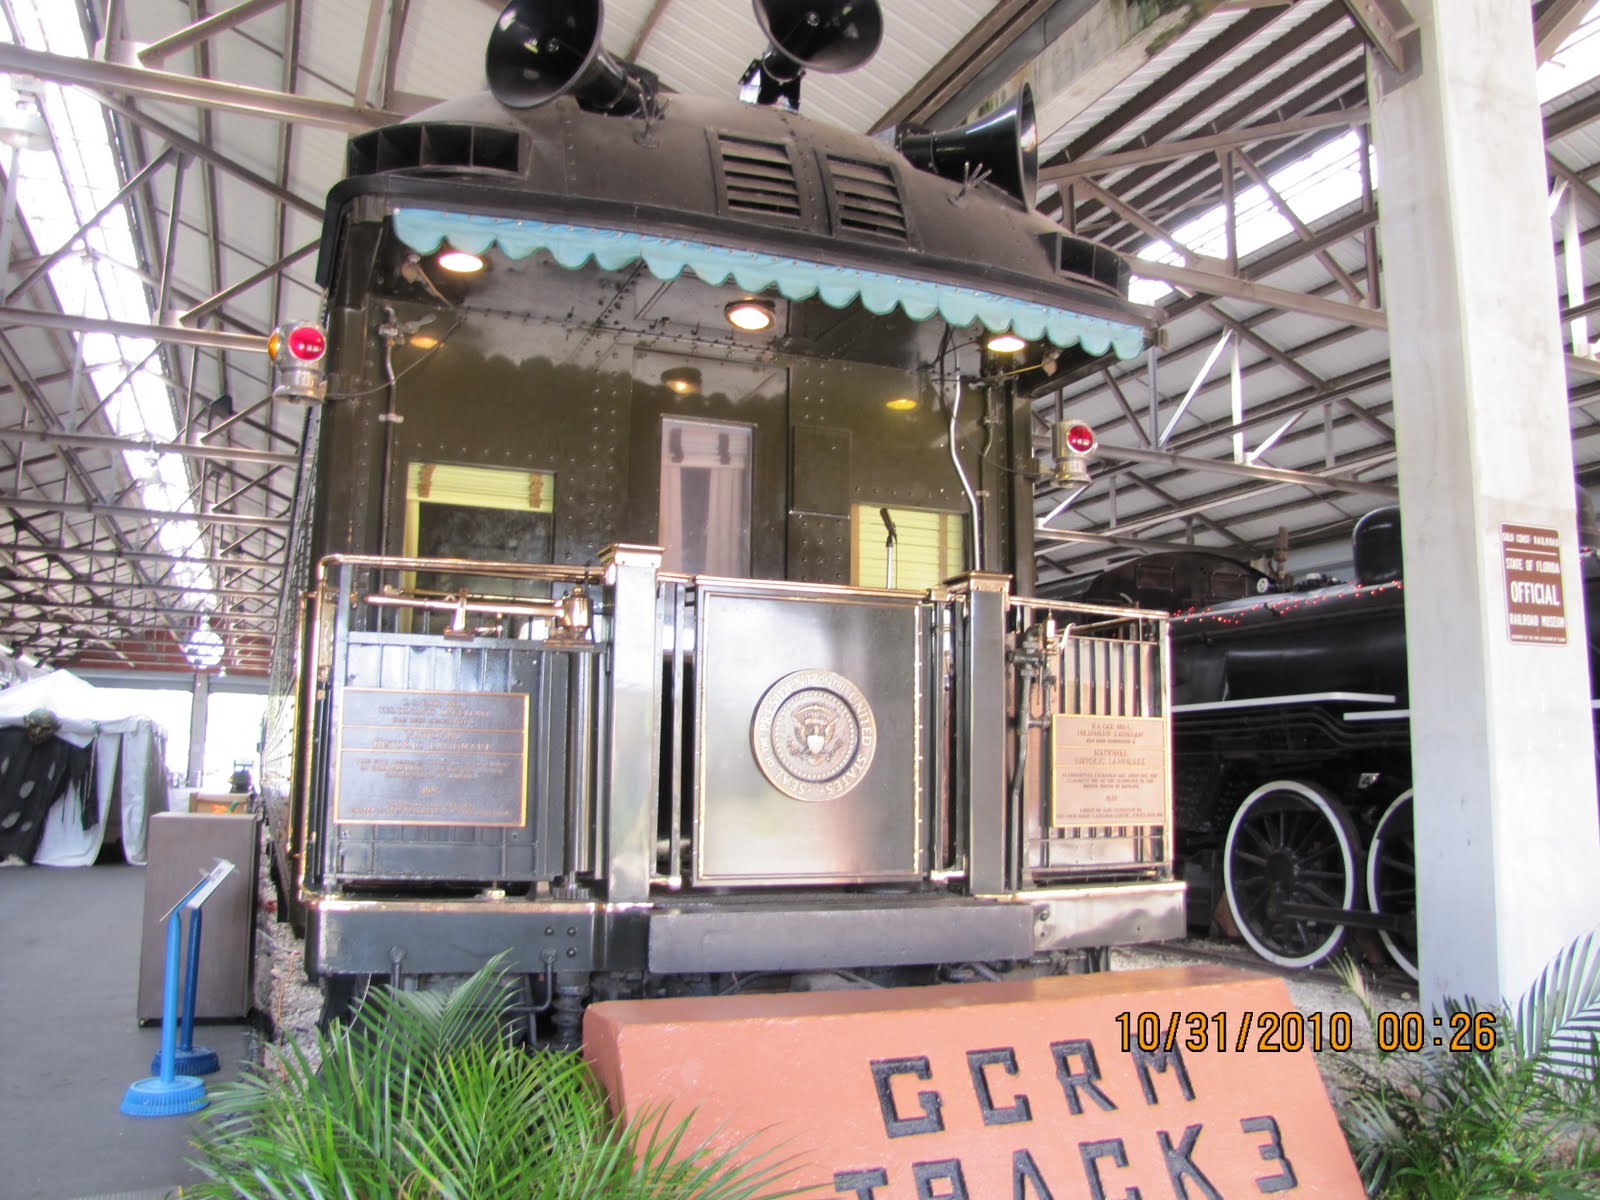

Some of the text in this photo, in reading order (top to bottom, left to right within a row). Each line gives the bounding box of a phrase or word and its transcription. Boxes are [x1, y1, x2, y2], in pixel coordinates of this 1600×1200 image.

[1533, 535, 1559, 547] RAILROAD
[1505, 557, 1561, 574] STATE OF FLORIDA
[1510, 580, 1560, 606] OFFICIAL
[1509, 613, 1565, 628] RAILROAD MUSEUM
[759, 674, 814, 731] PRESIDENT
[848, 691, 873, 747] UNITED
[760, 736, 769, 753] THE
[764, 756, 774, 768] OF
[826, 754, 867, 795] STATES
[774, 768, 805, 795] SEAL
[870, 1030, 1196, 1138] GCRM
[1240, 1115, 1298, 1194] 3
